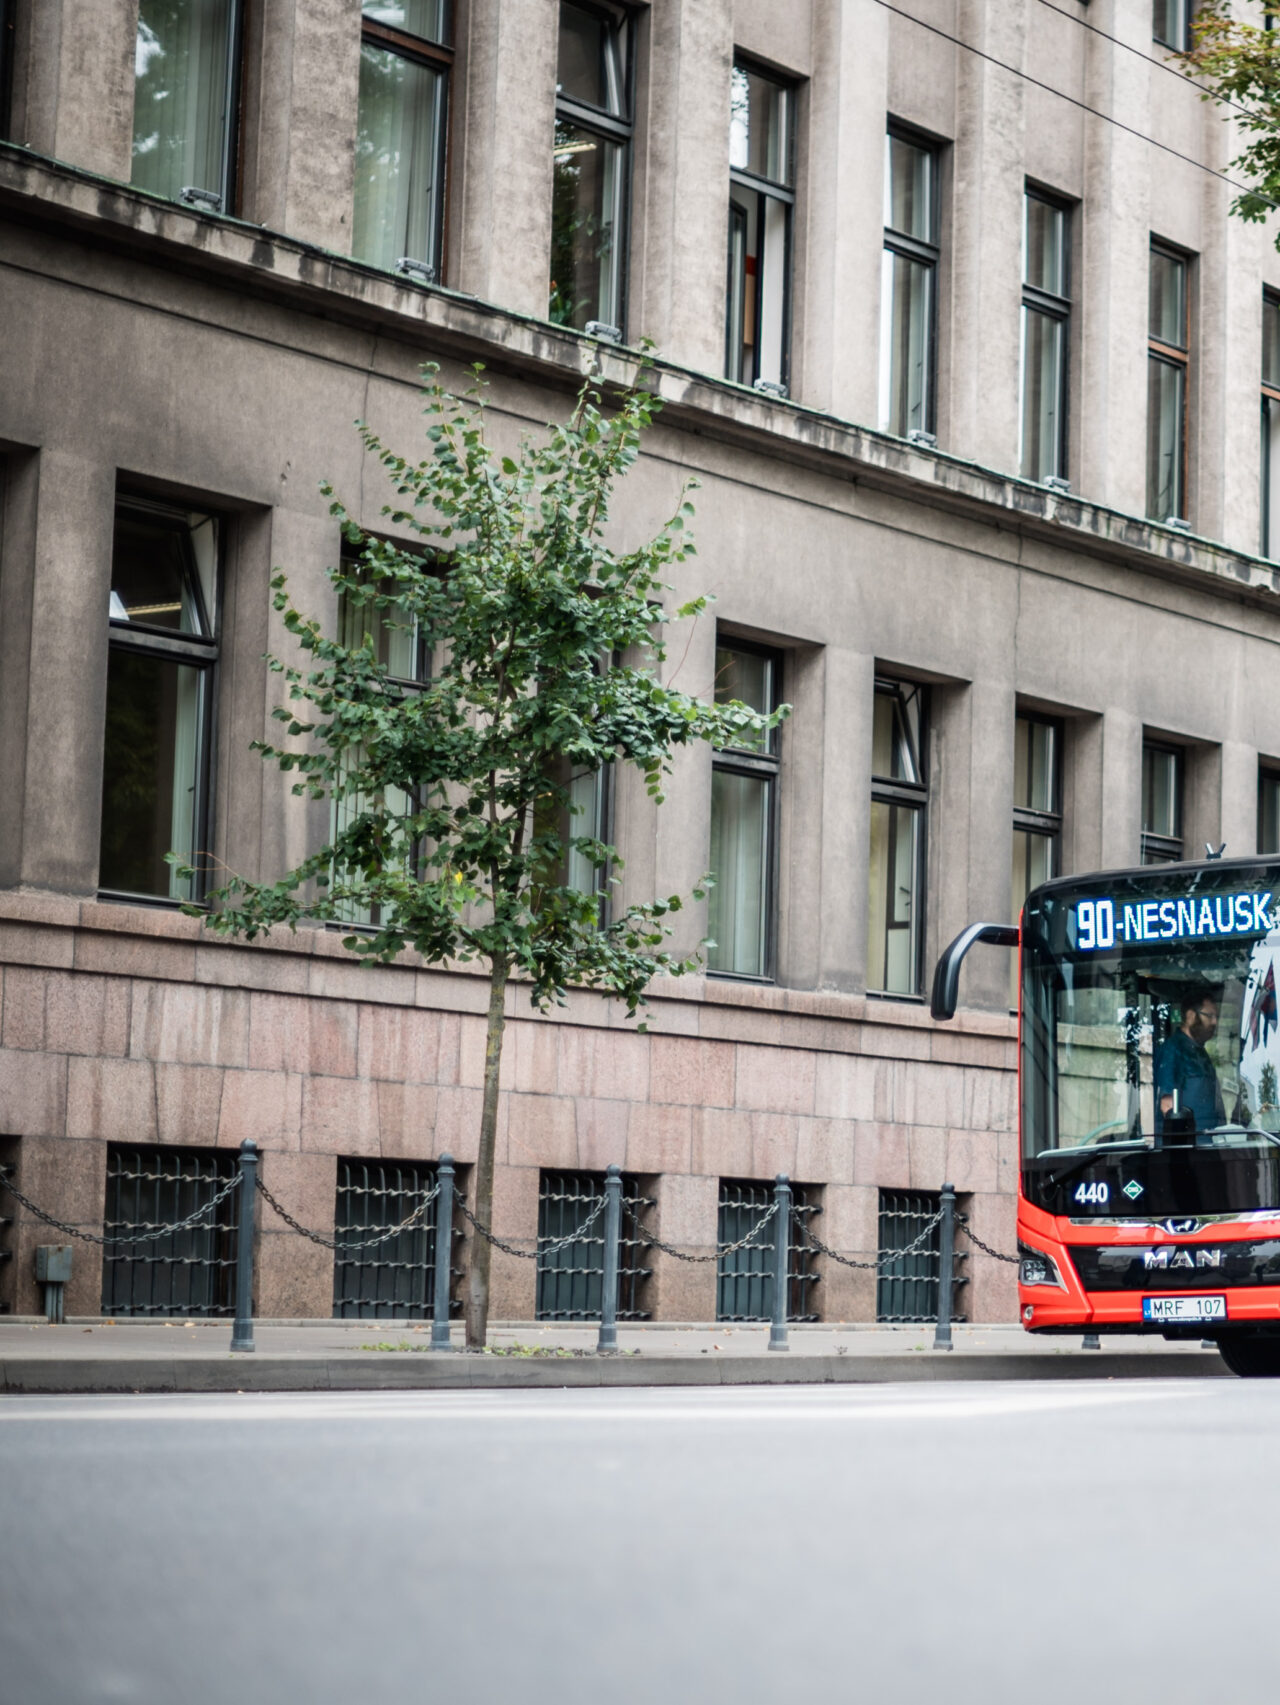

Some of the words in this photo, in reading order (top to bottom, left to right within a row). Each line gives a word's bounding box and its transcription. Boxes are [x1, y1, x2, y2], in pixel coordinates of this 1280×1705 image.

[1075, 1182, 1109, 1204] 440
[1144, 1249, 1220, 1269] MAN
[1153, 1300, 1185, 1316] MRF
[1196, 1299, 1221, 1315] 107
